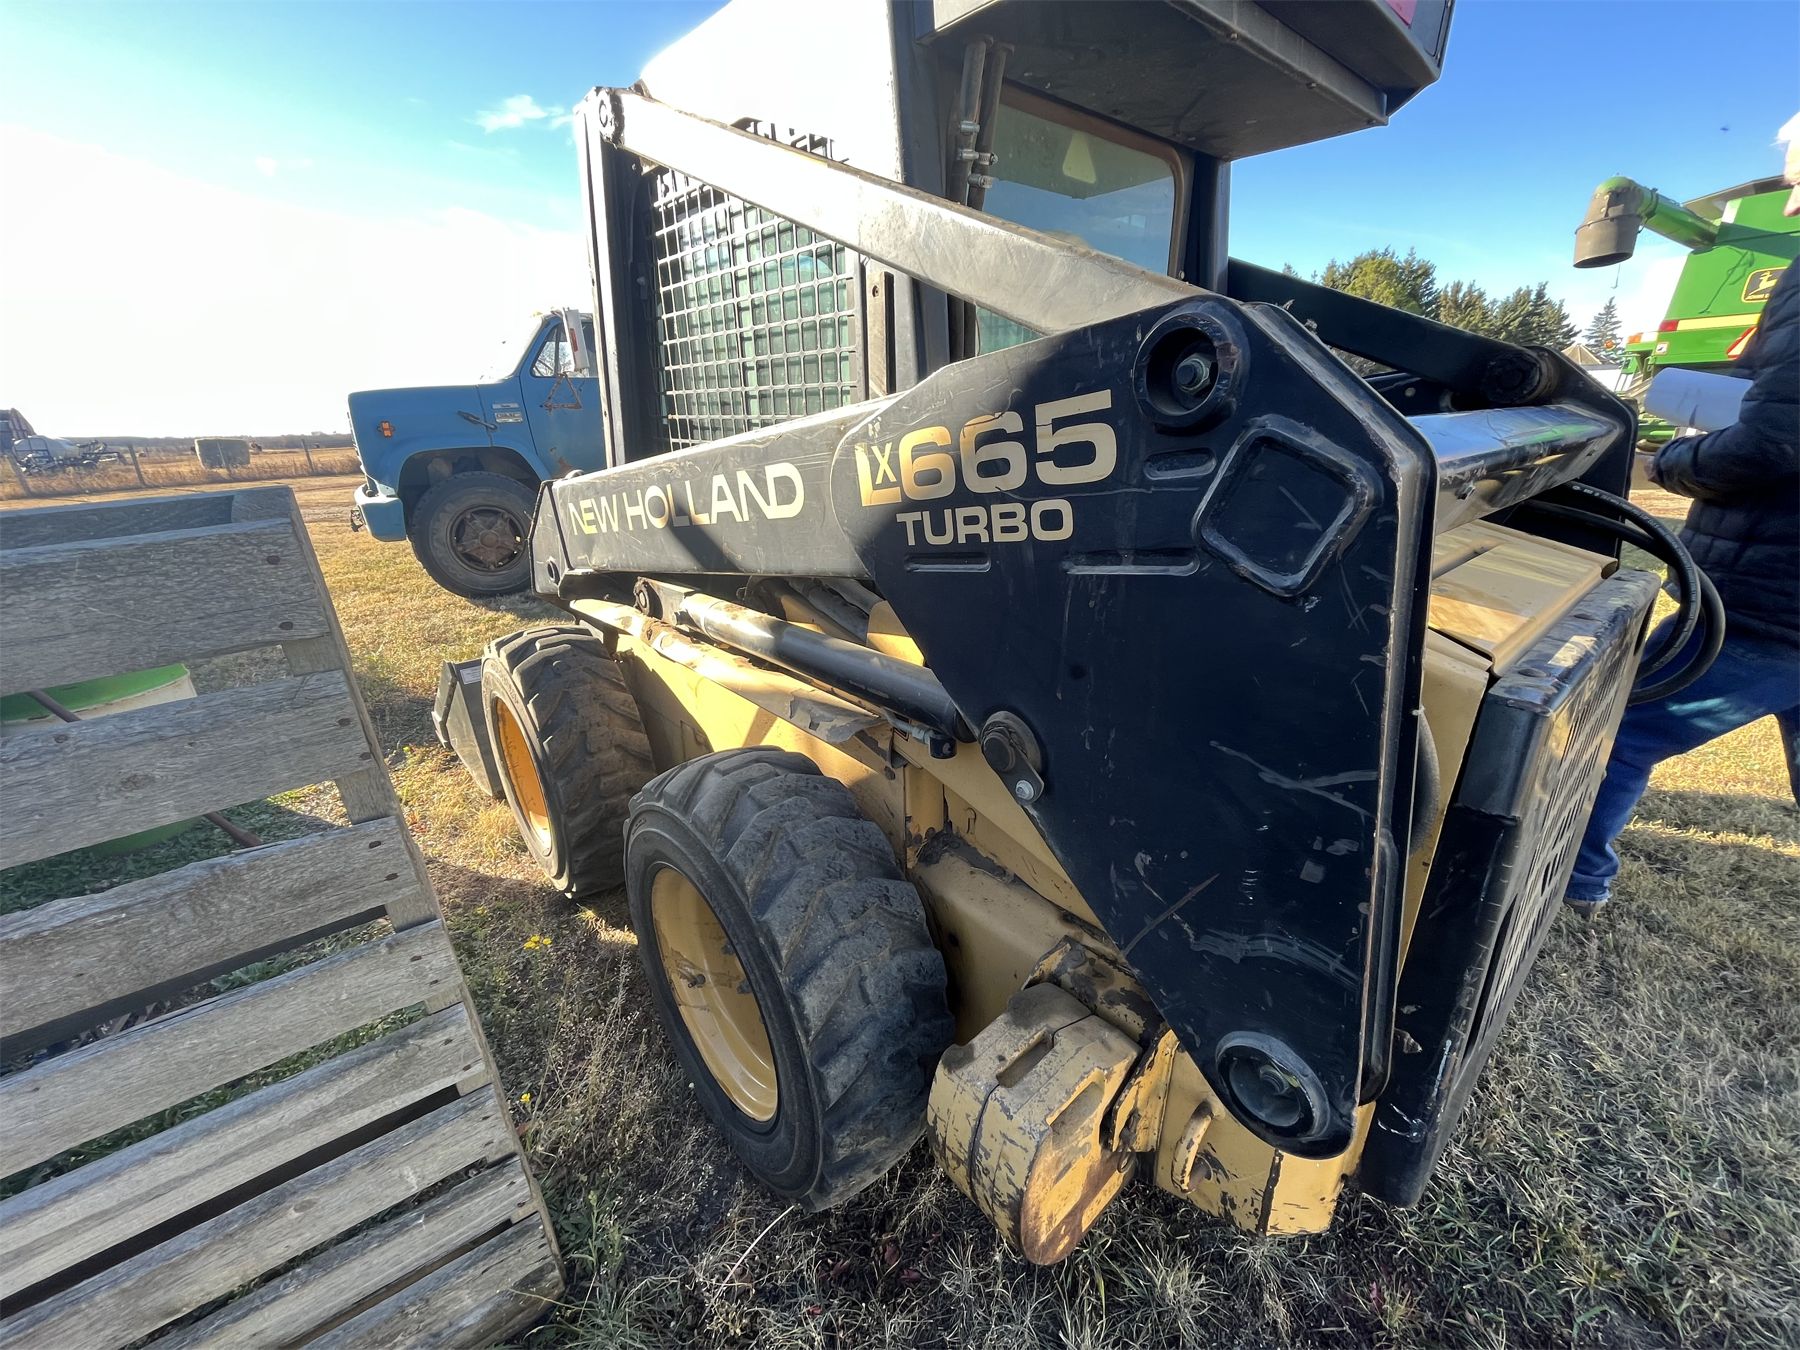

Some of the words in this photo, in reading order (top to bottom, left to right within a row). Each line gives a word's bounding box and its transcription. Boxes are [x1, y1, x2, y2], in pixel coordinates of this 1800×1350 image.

[568, 494, 619, 536] NEW
[622, 462, 805, 531] HOLLAND
[896, 499, 1074, 546] TURBO
